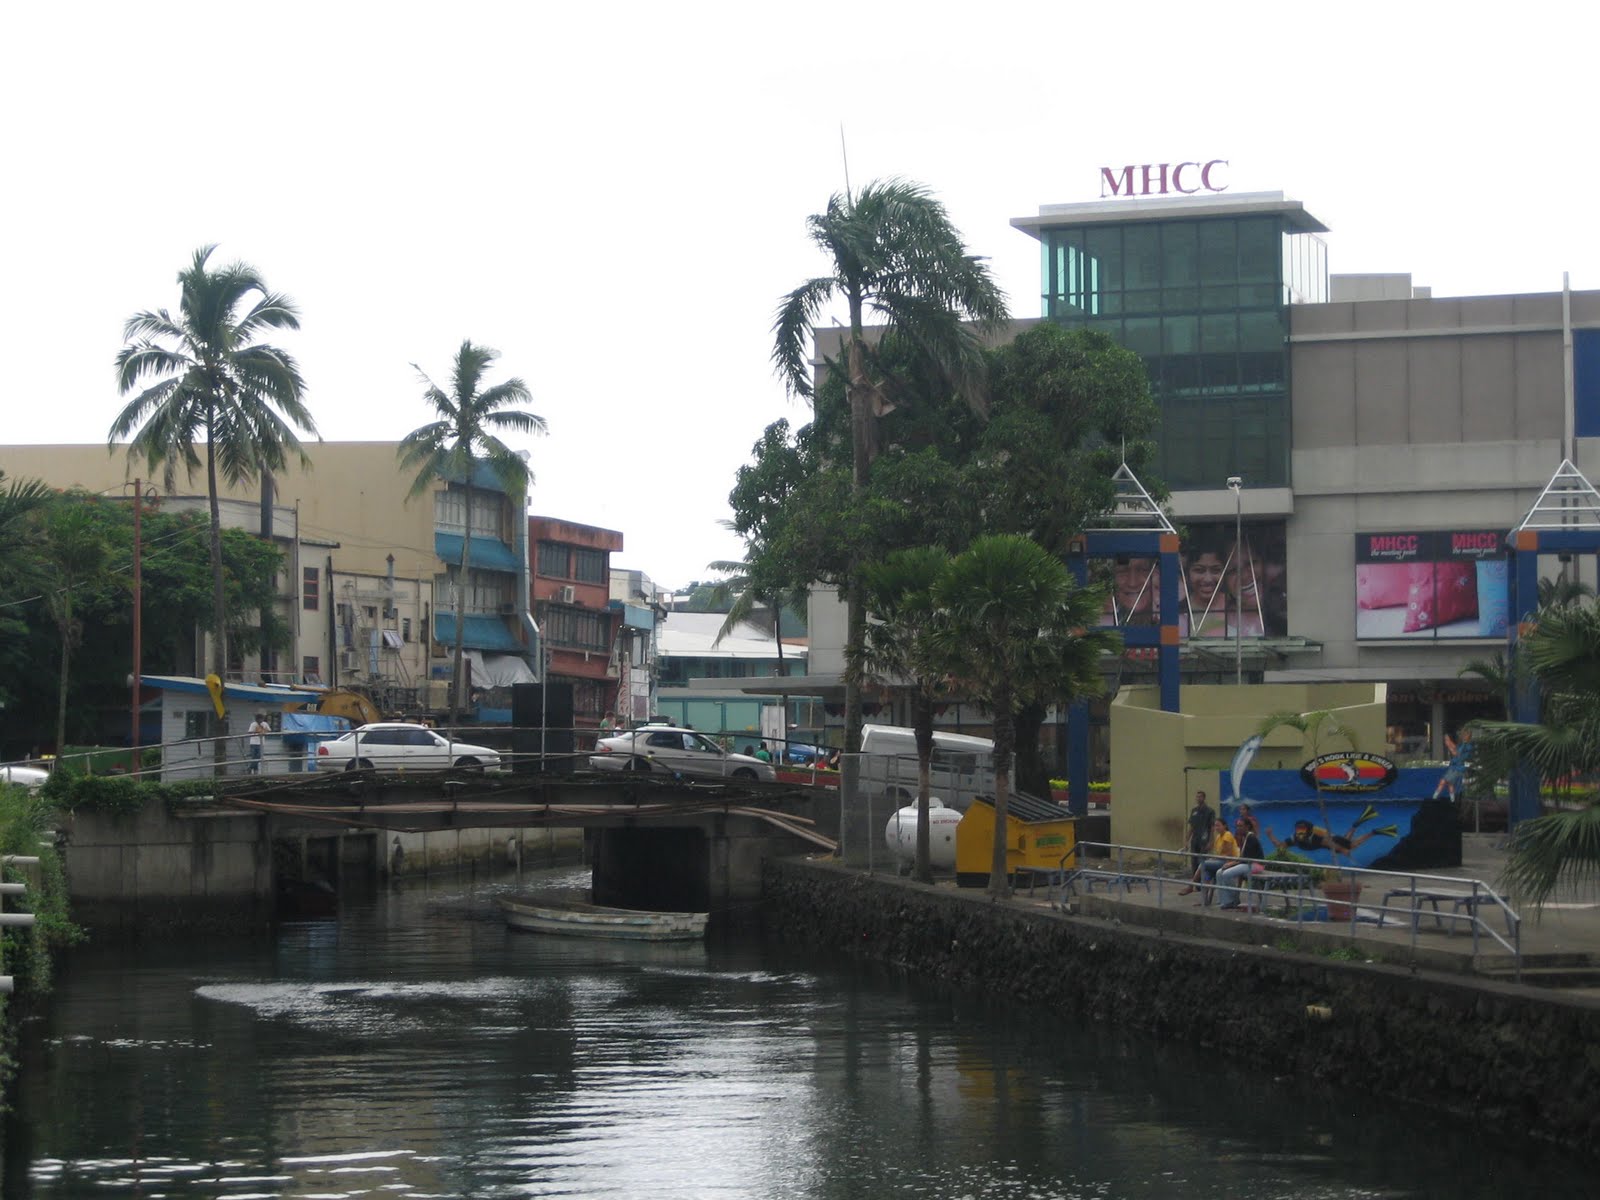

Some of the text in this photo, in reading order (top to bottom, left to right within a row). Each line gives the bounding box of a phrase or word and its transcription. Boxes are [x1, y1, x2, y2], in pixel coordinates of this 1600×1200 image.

[1100, 159, 1229, 198] MHCC
[1370, 535, 1418, 551] MHCC
[1451, 532, 1497, 549] MHCC
[307, 703, 317, 711] CAT
[1324, 753, 1345, 762] HOOK
